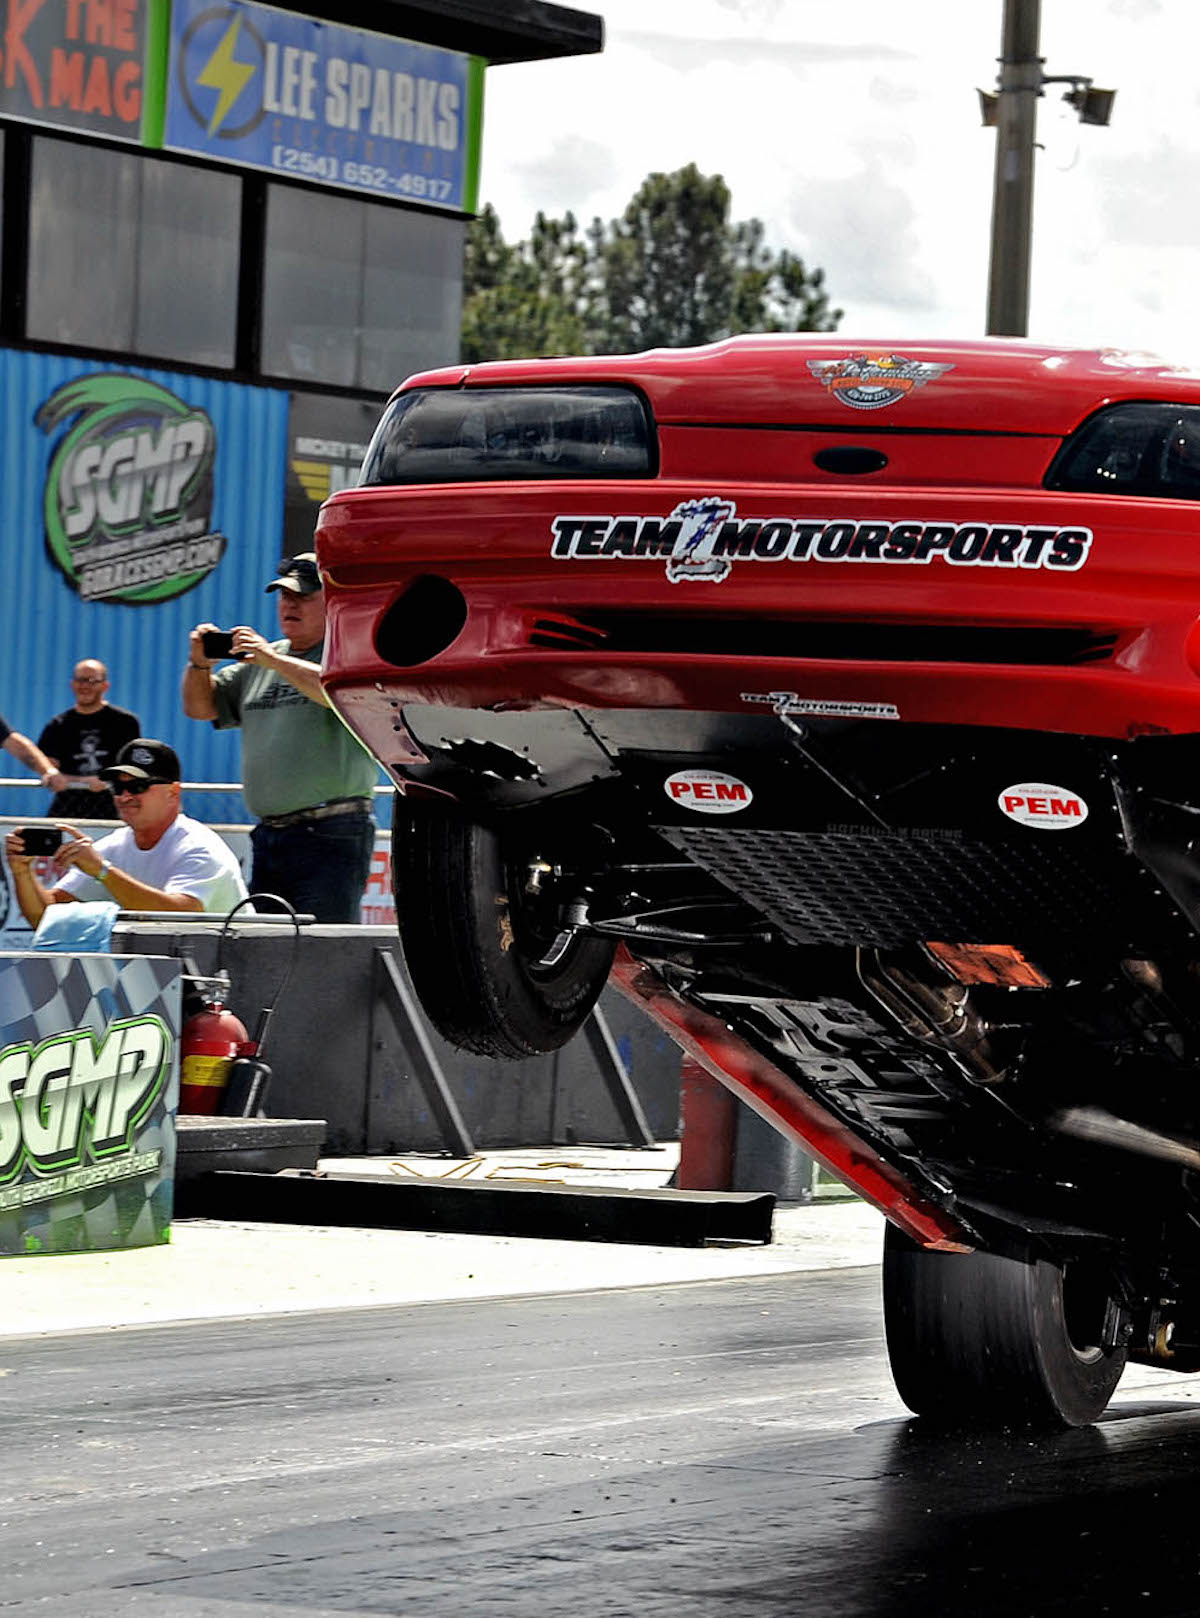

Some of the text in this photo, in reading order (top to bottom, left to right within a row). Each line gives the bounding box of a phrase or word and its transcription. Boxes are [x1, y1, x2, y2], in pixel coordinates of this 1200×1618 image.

[65, 0, 138, 51] THE
[49, 47, 142, 123] MAG
[263, 42, 460, 151] LEE SPARKS
[271, 145, 453, 200] (254) 652-4917
[62, 415, 208, 537] SGMP
[552, 518, 684, 558] TEAM
[710, 519, 1092, 568] MOTORSPORTS
[669, 781, 748, 801] PEM
[1004, 796, 1082, 816] PEM
